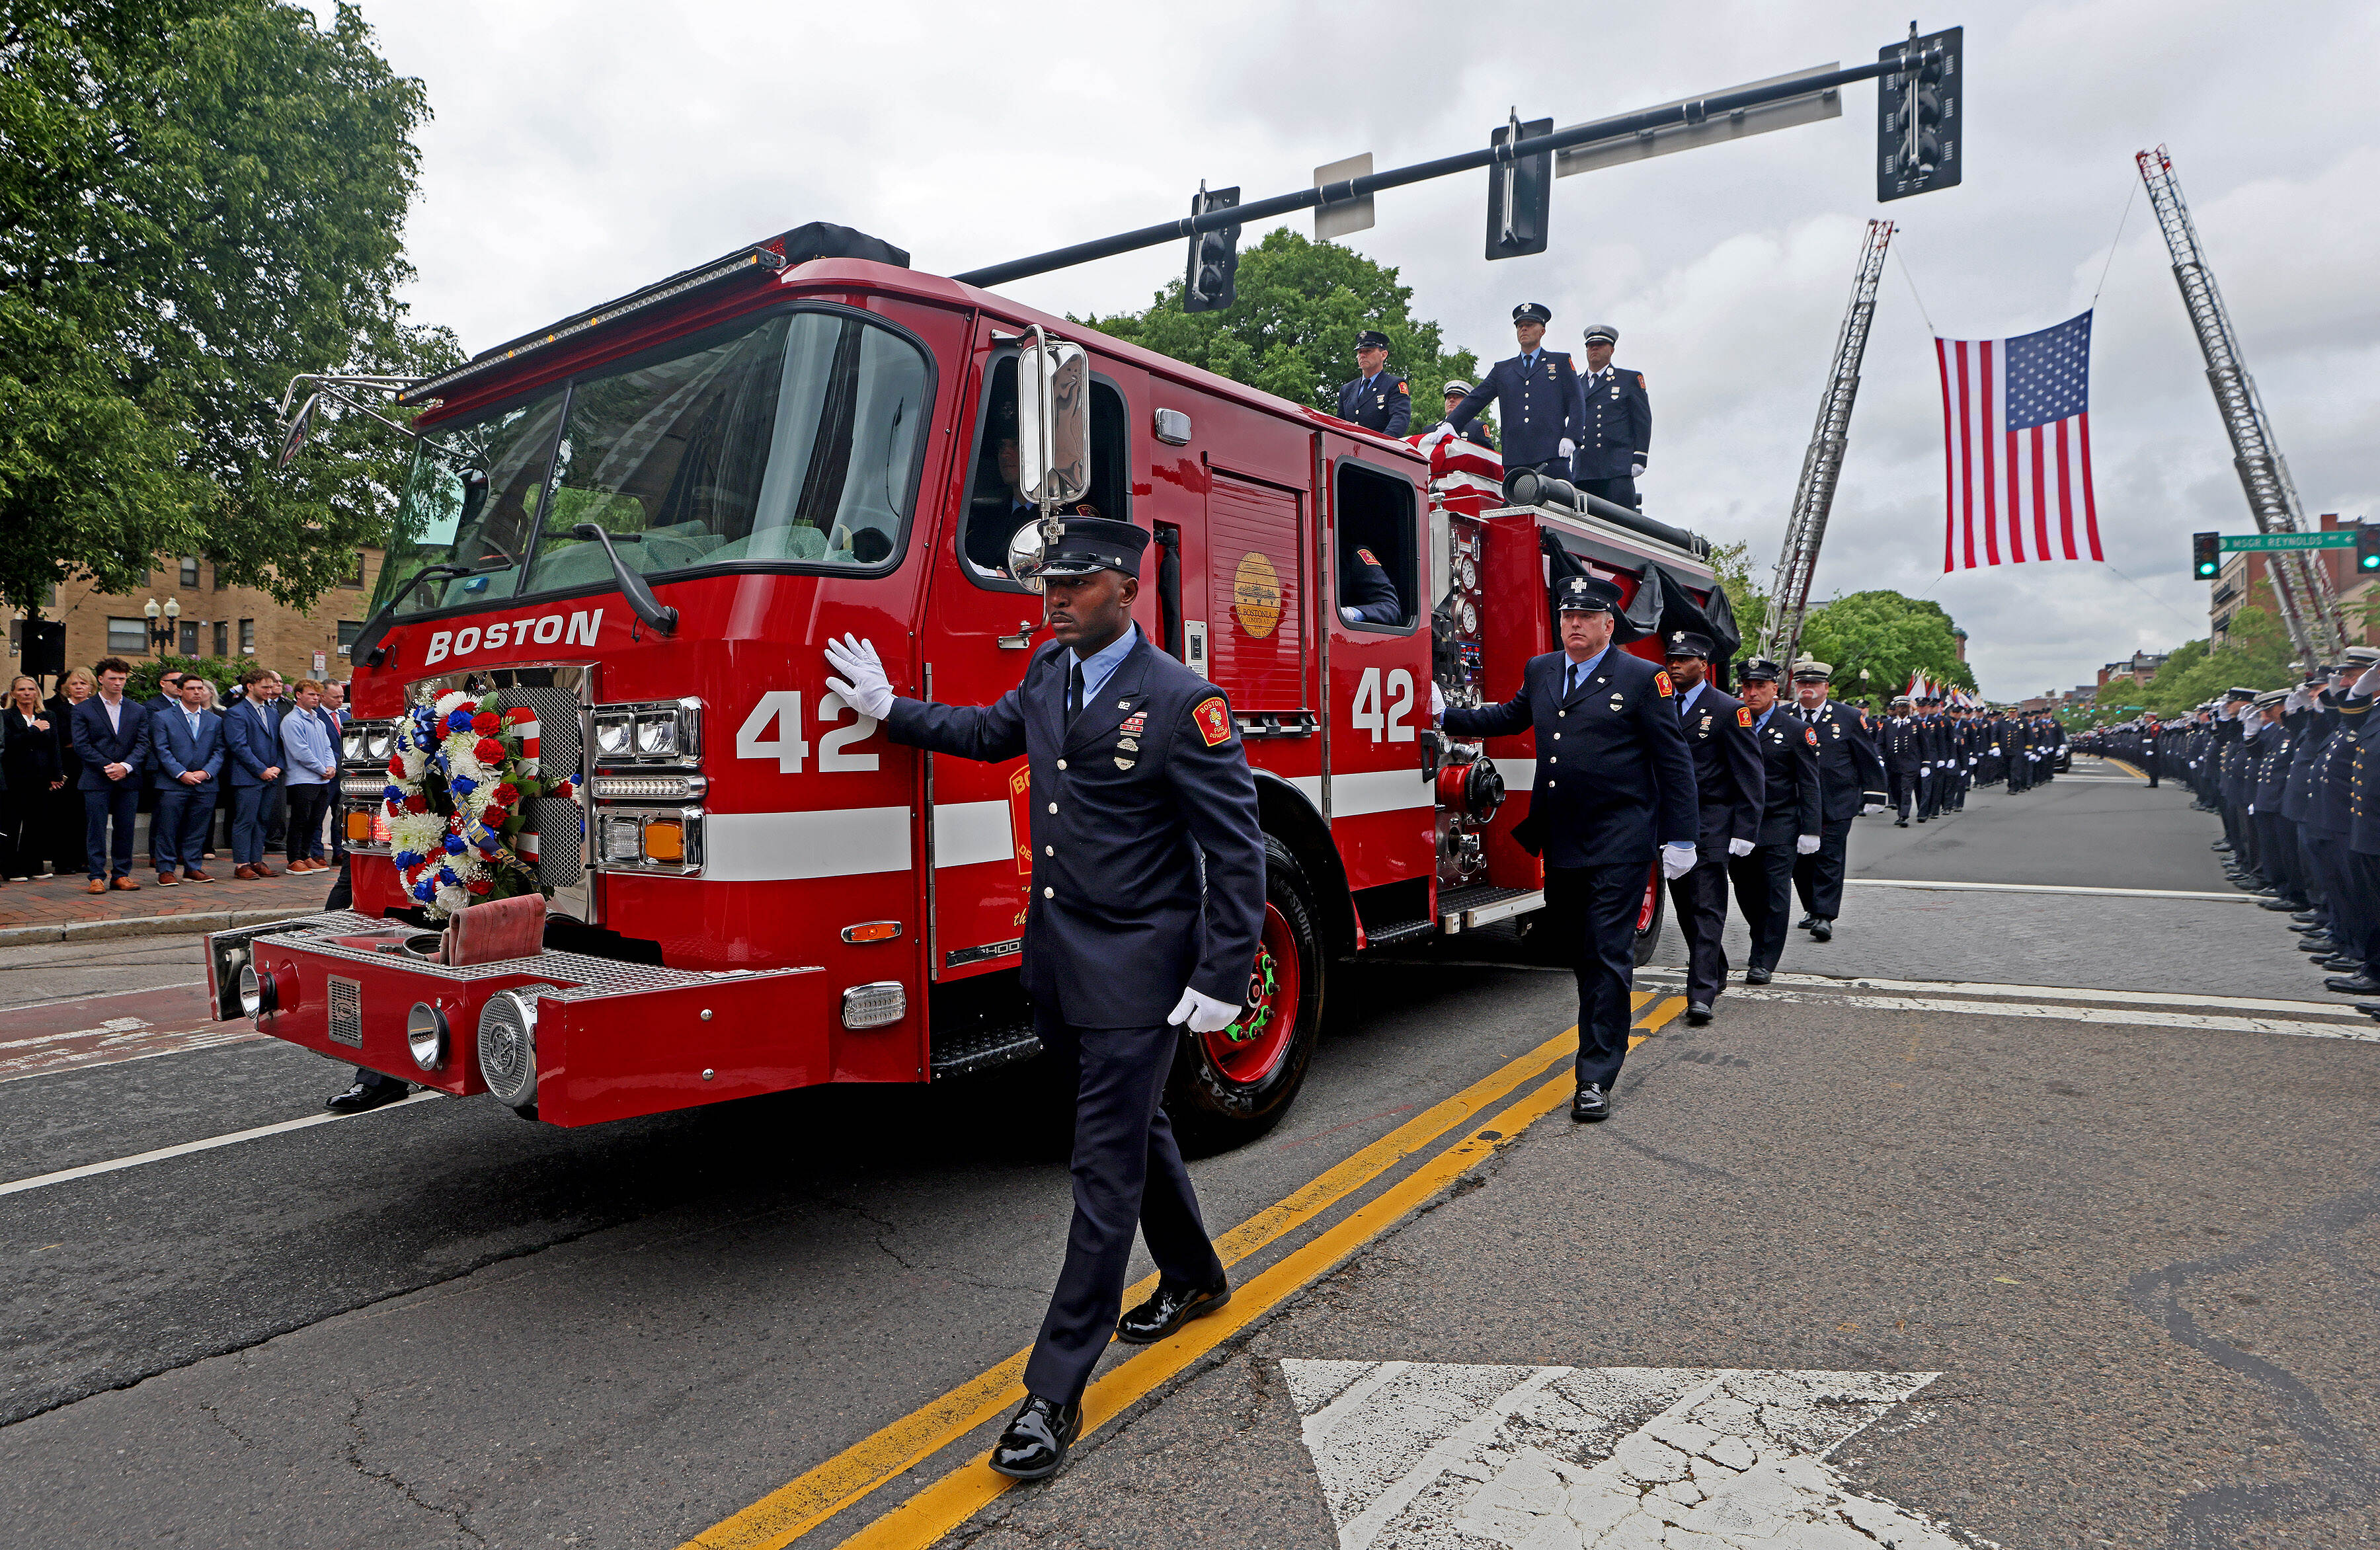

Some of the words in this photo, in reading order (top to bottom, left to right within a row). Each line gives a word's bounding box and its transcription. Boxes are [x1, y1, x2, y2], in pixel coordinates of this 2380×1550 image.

[2268, 535, 2322, 547] REYNOLDS
[1243, 608, 1272, 618] BOSTONIA
[425, 608, 604, 666] BOSTON
[1199, 700, 1222, 714] BOSTON
[1352, 667, 1415, 743] 42
[736, 690, 879, 774] 42
[1209, 727, 1228, 738] DEPARTMENT
[1214, 724, 1225, 734] FIRE
